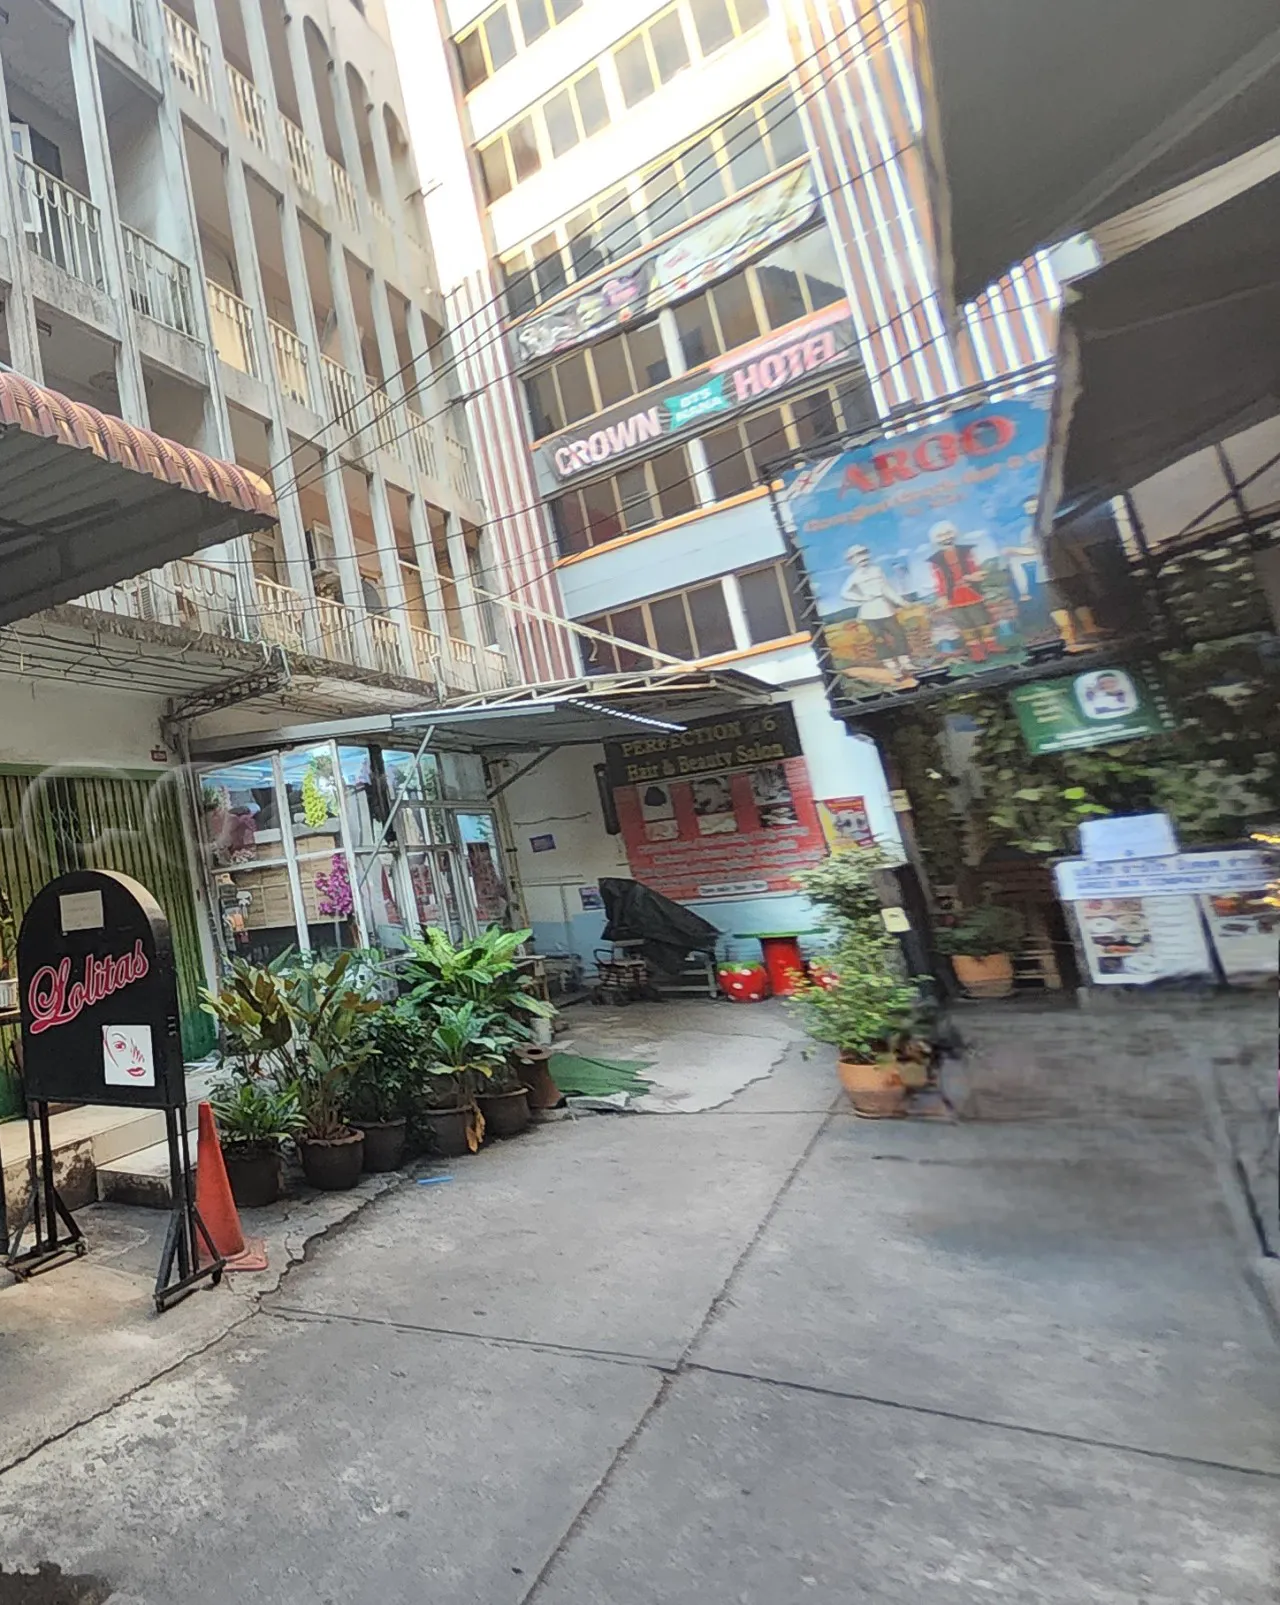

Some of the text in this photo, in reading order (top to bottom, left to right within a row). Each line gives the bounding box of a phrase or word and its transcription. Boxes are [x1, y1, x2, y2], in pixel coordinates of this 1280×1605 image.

[554, 331, 843, 477] CROWN HOTEL
[621, 720, 742, 757] PERFECTION
[627, 763, 659, 782] Hair
[678, 751, 733, 773] Beauty
[735, 742, 785, 764] Salon
[28, 938, 149, 1035] Lolitas
